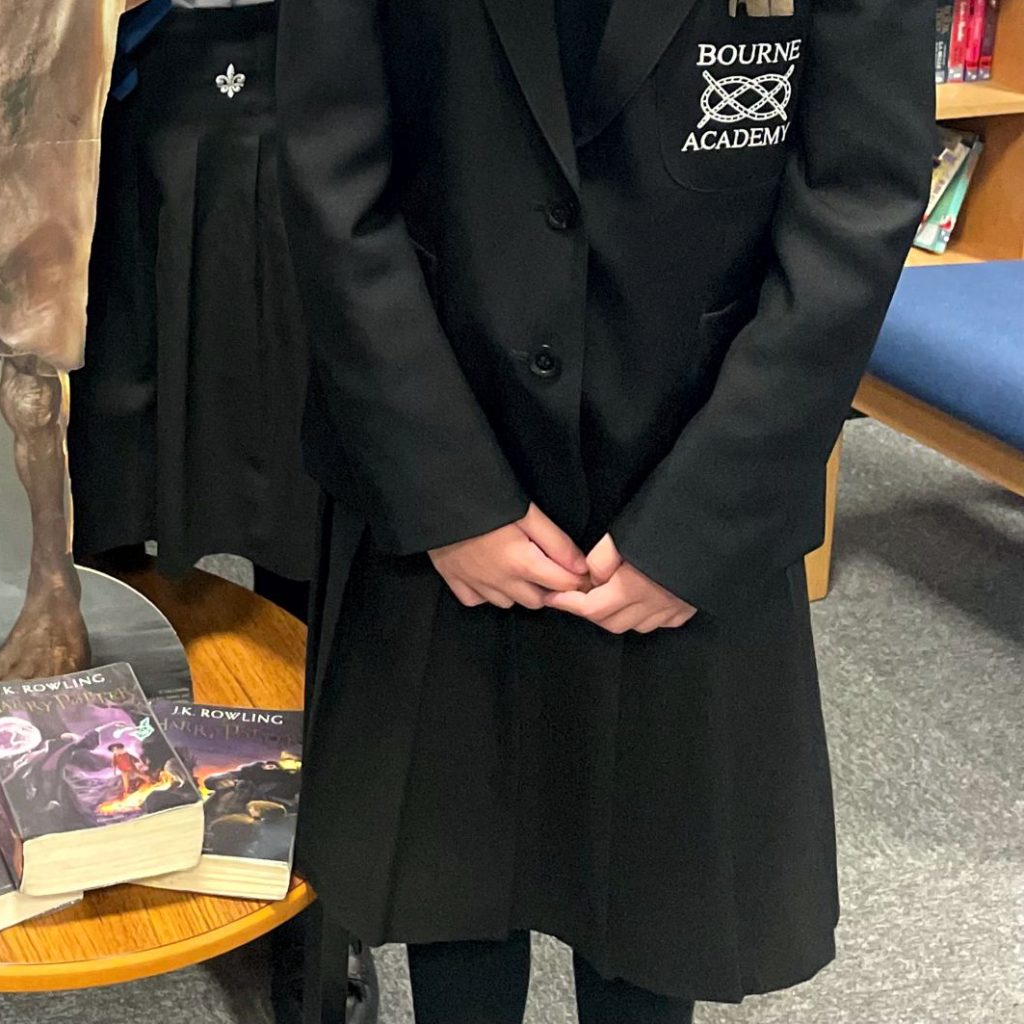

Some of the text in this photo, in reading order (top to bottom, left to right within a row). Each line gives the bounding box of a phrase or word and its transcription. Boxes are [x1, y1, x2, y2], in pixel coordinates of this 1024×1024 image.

[696, 39, 802, 66] BOURNE
[681, 121, 791, 152] ACADEMY
[21, 673, 106, 694] ROWLING
[200, 709, 284, 726] ROWLING
